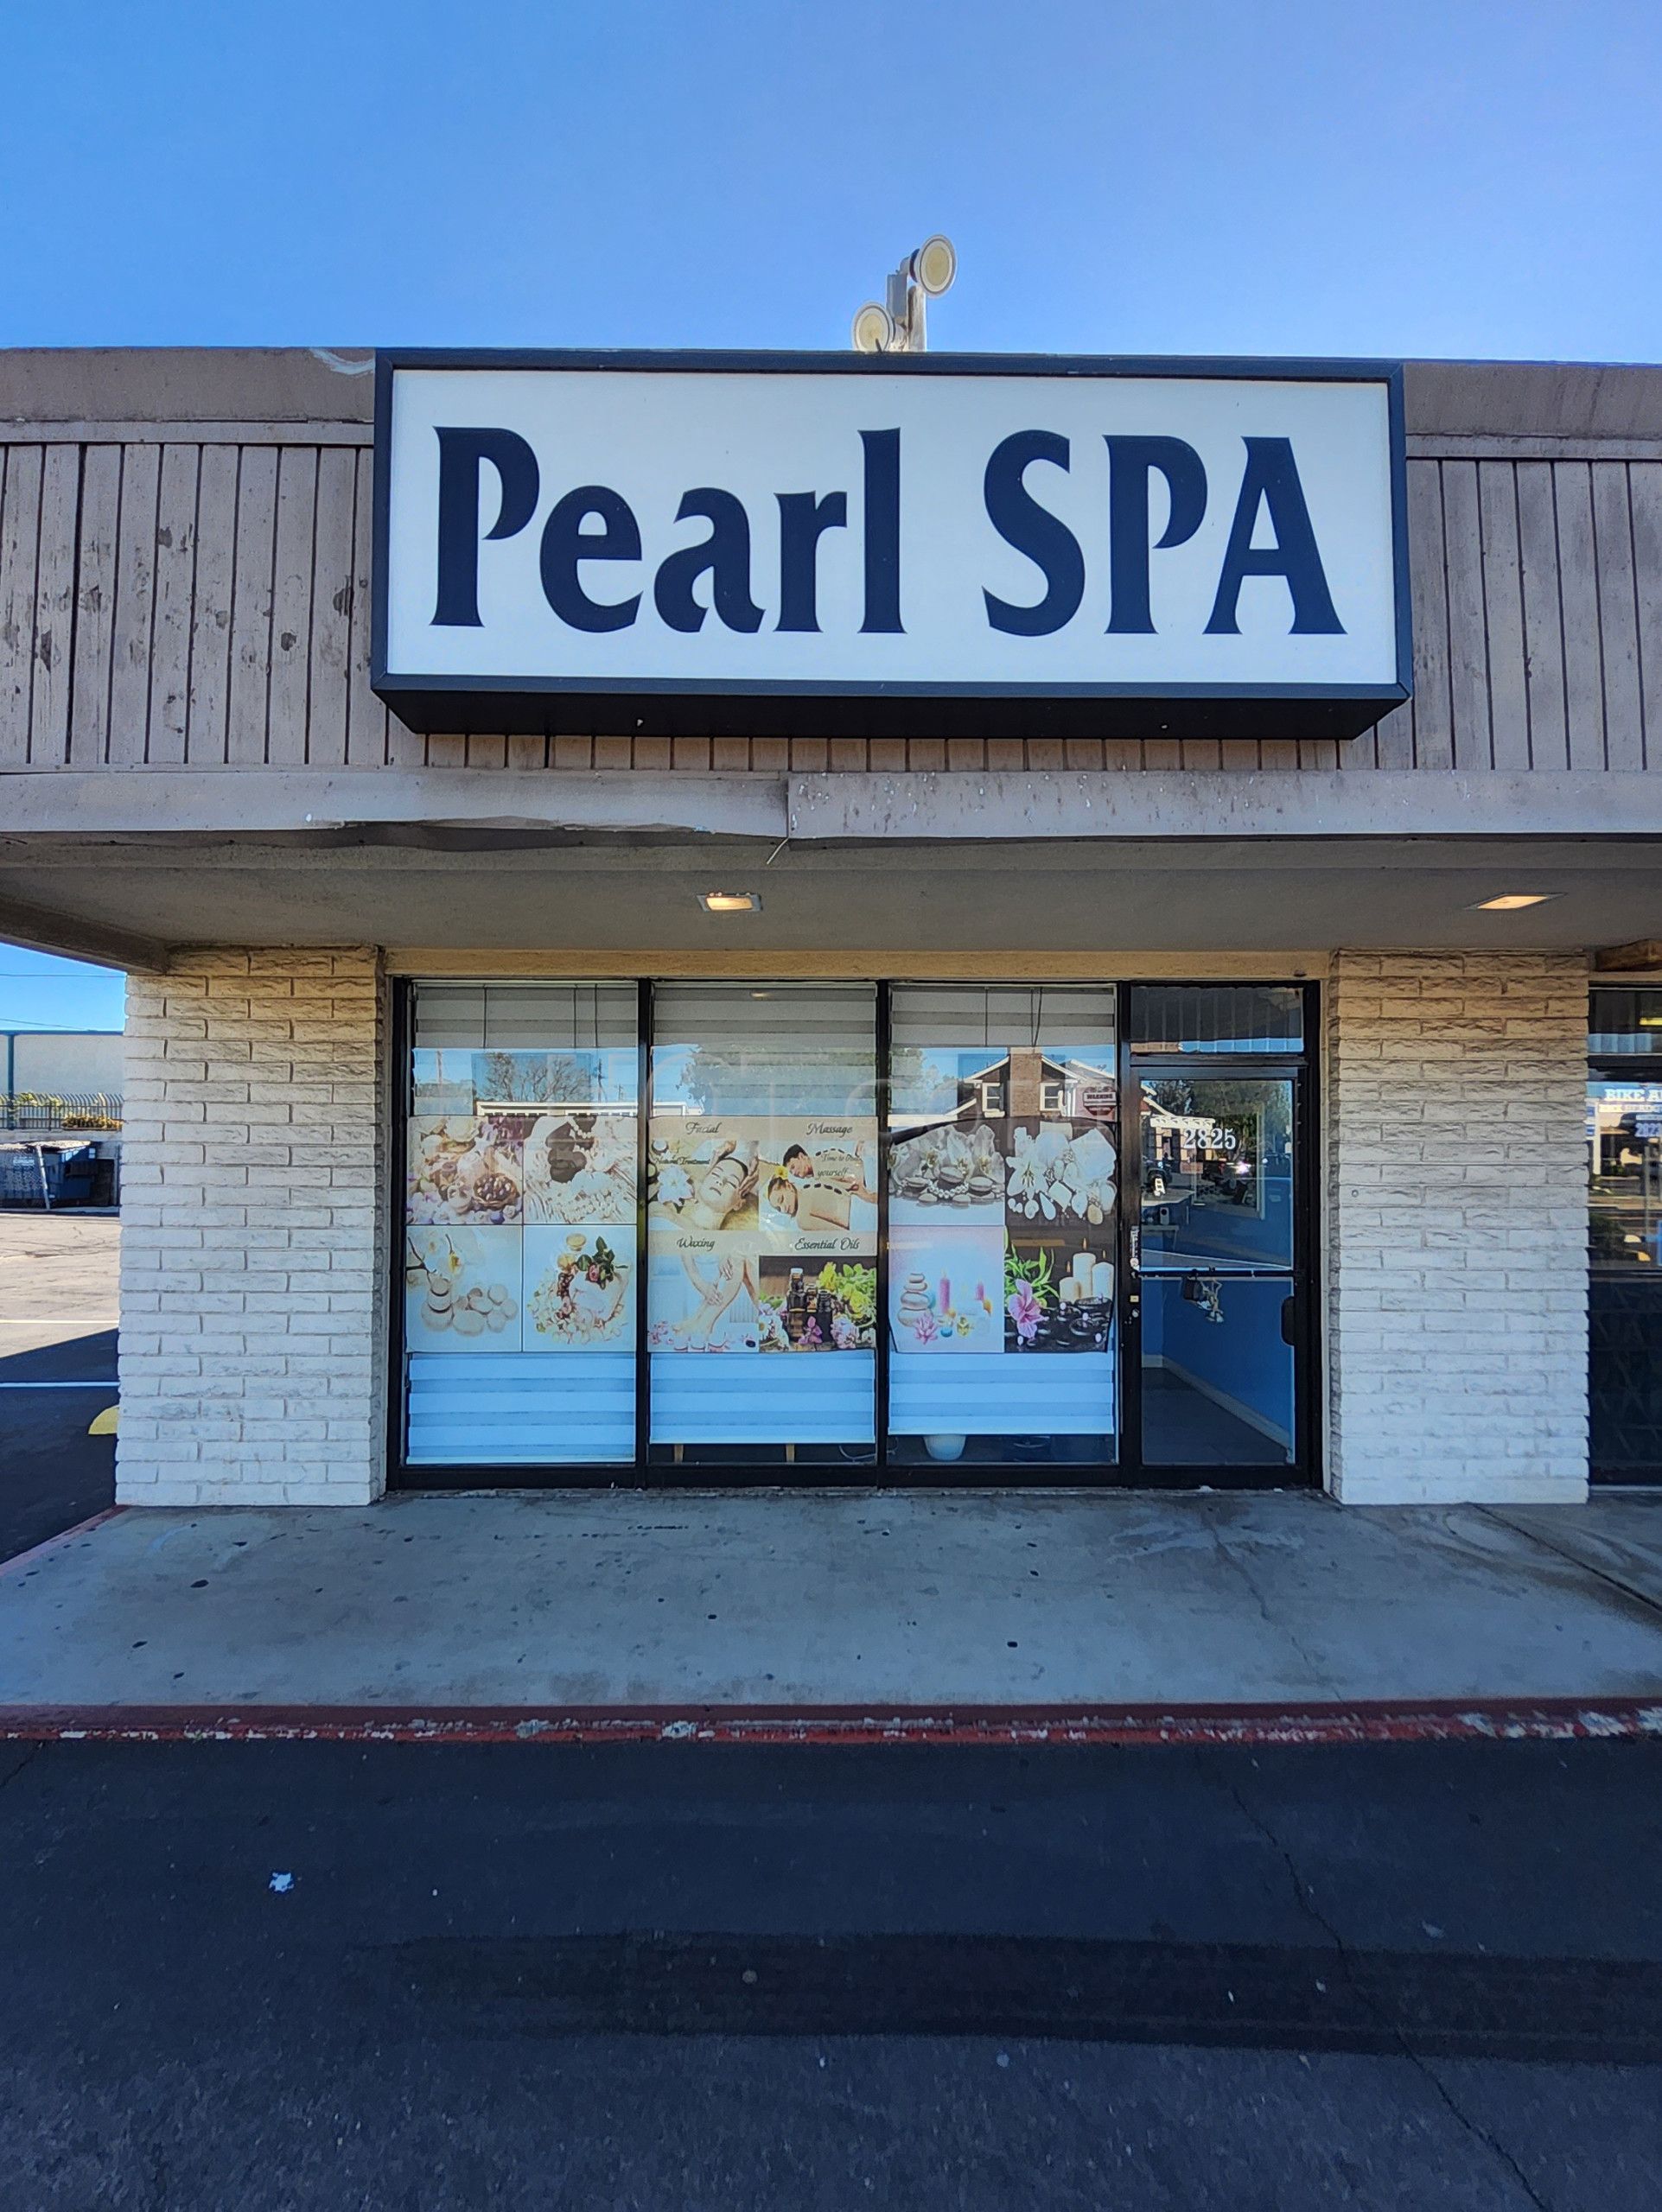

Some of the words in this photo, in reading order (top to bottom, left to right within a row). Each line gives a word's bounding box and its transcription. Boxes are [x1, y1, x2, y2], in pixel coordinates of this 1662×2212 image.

[430, 426, 907, 633] Pearl
[983, 429, 1347, 638] SPA
[1604, 1089, 1646, 1102] BIKE
[685, 1122, 723, 1135] Facial
[806, 1122, 853, 1138] Massage
[1183, 1128, 1236, 1150] 2825
[677, 1236, 716, 1251] Waxing
[795, 1236, 836, 1250] Essential
[840, 1236, 860, 1250] Oils
